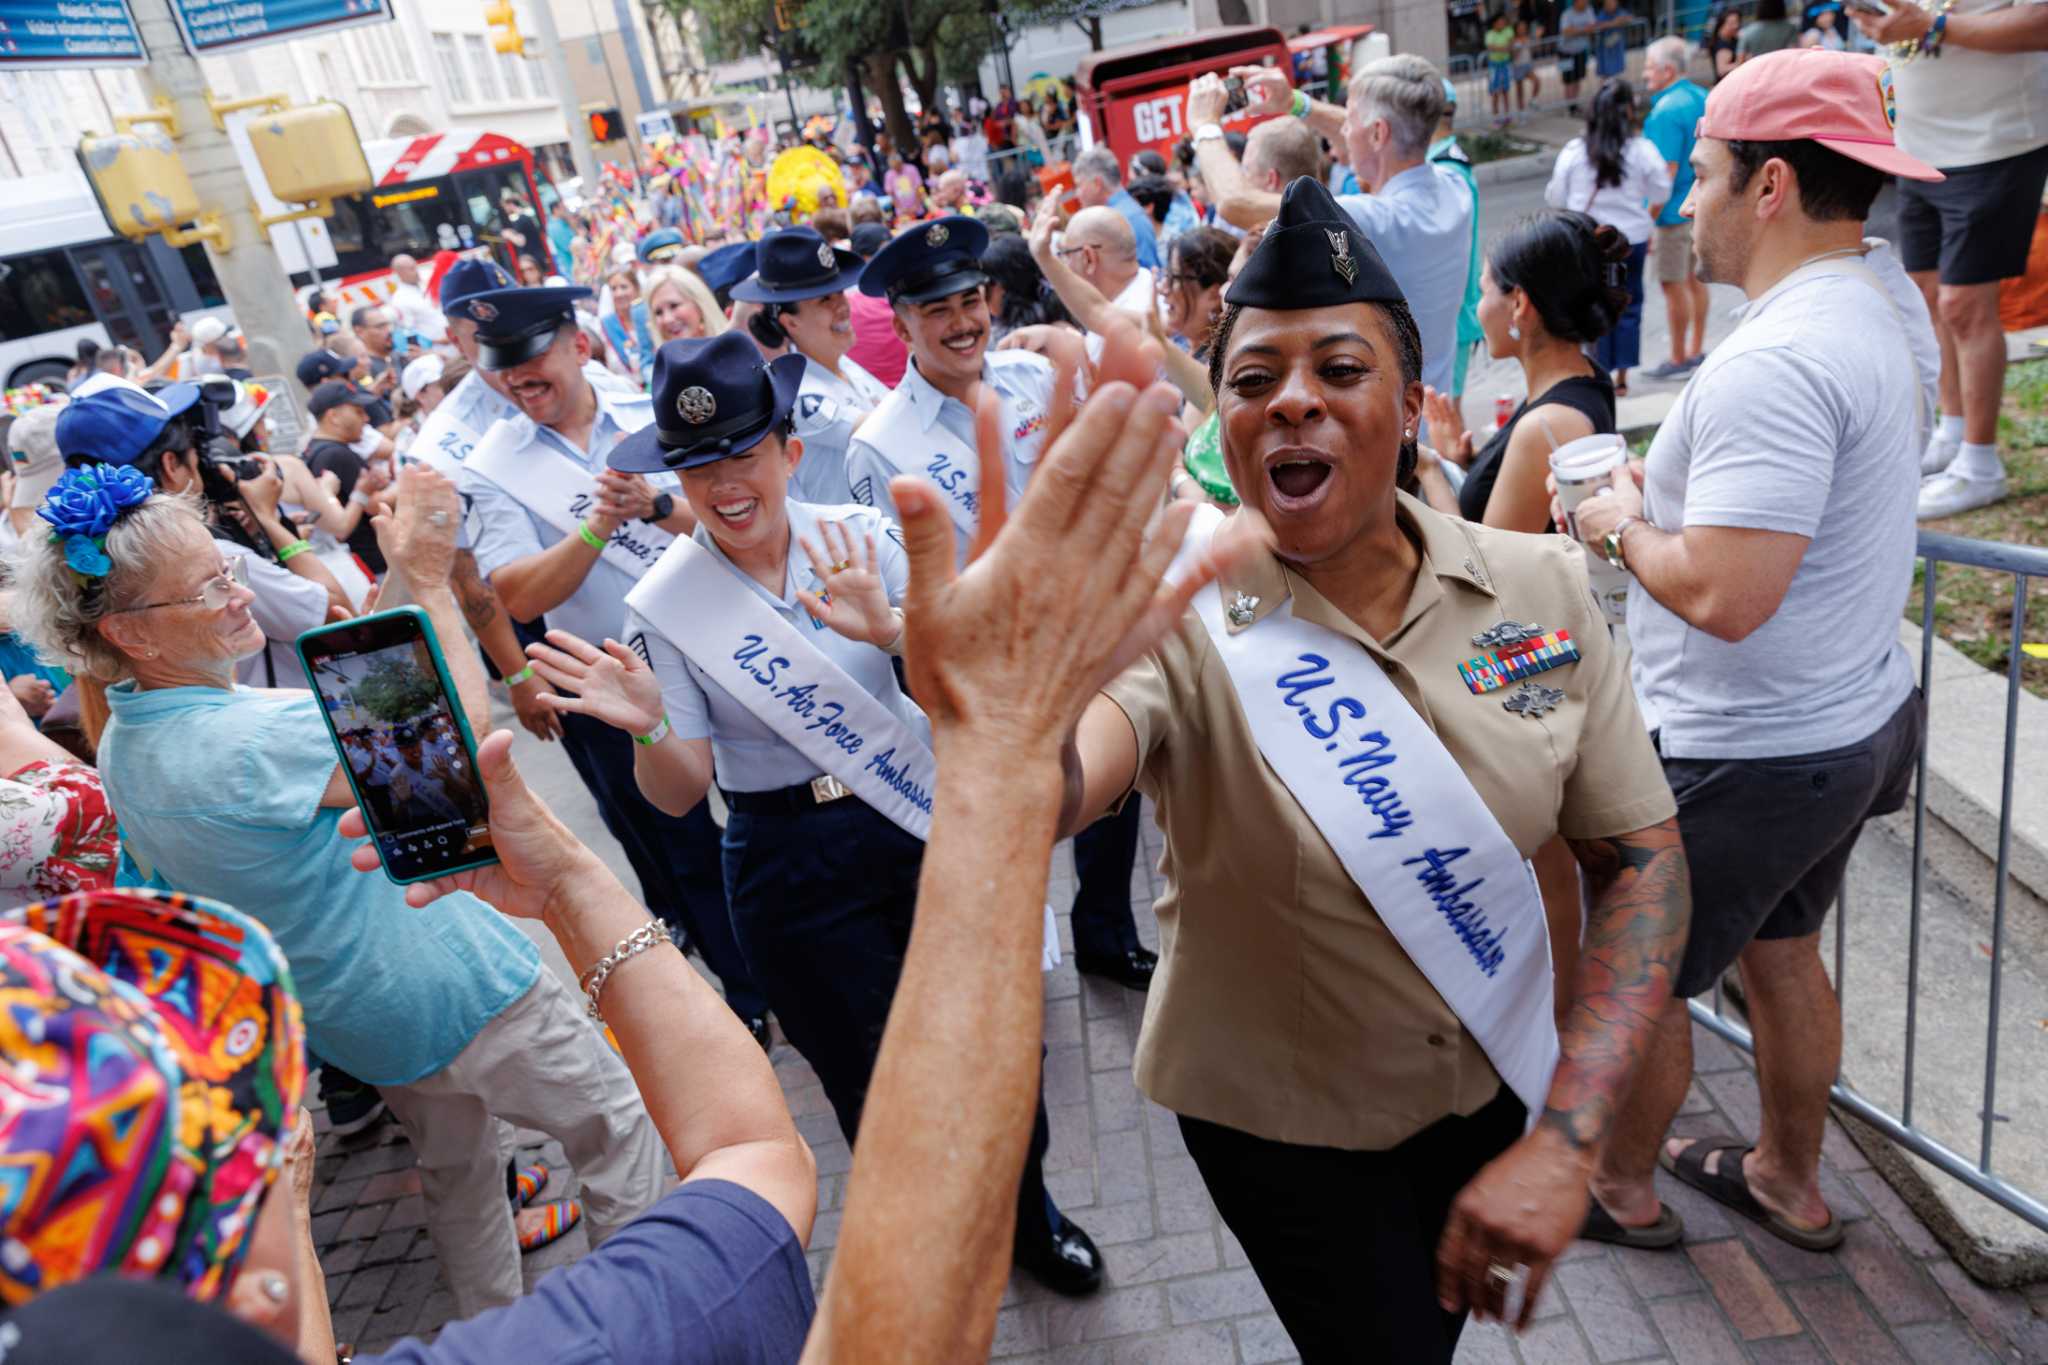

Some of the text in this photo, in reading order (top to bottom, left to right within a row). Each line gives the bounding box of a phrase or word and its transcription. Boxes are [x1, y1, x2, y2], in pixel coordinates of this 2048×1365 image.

[1132, 94, 1184, 144] GET
[926, 453, 967, 496] U.S.
[733, 634, 935, 815] U.S. Air Force Ambassa
[1276, 653, 1367, 753] U.S.
[1337, 730, 1414, 840] Navy
